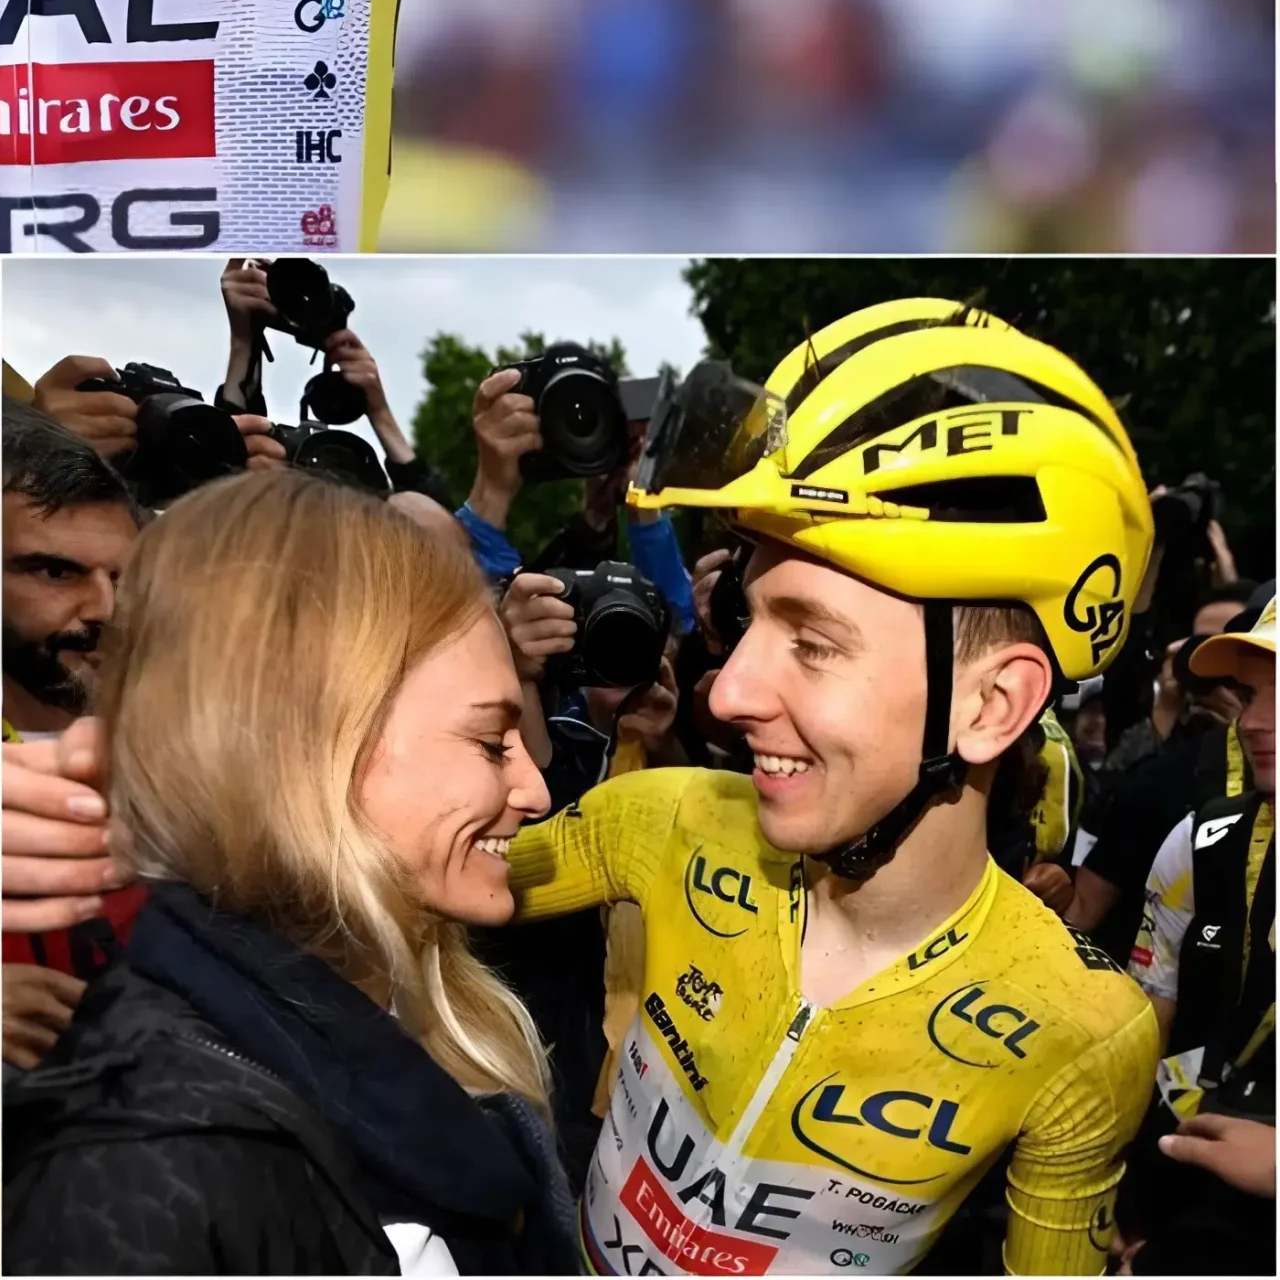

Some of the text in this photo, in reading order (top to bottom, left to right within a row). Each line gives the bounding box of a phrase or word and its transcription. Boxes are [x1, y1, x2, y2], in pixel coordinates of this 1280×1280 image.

[296, 130, 342, 163] IHC
[863, 409, 1033, 474] MET
[693, 856, 758, 915] LCL
[908, 927, 969, 971] LCL
[949, 986, 1041, 1059] LCL
[813, 1084, 973, 1156] LCL
[647, 1097, 816, 1240] UAE
[828, 1179, 843, 1195] T.
[635, 1180, 749, 1274] Emirates
